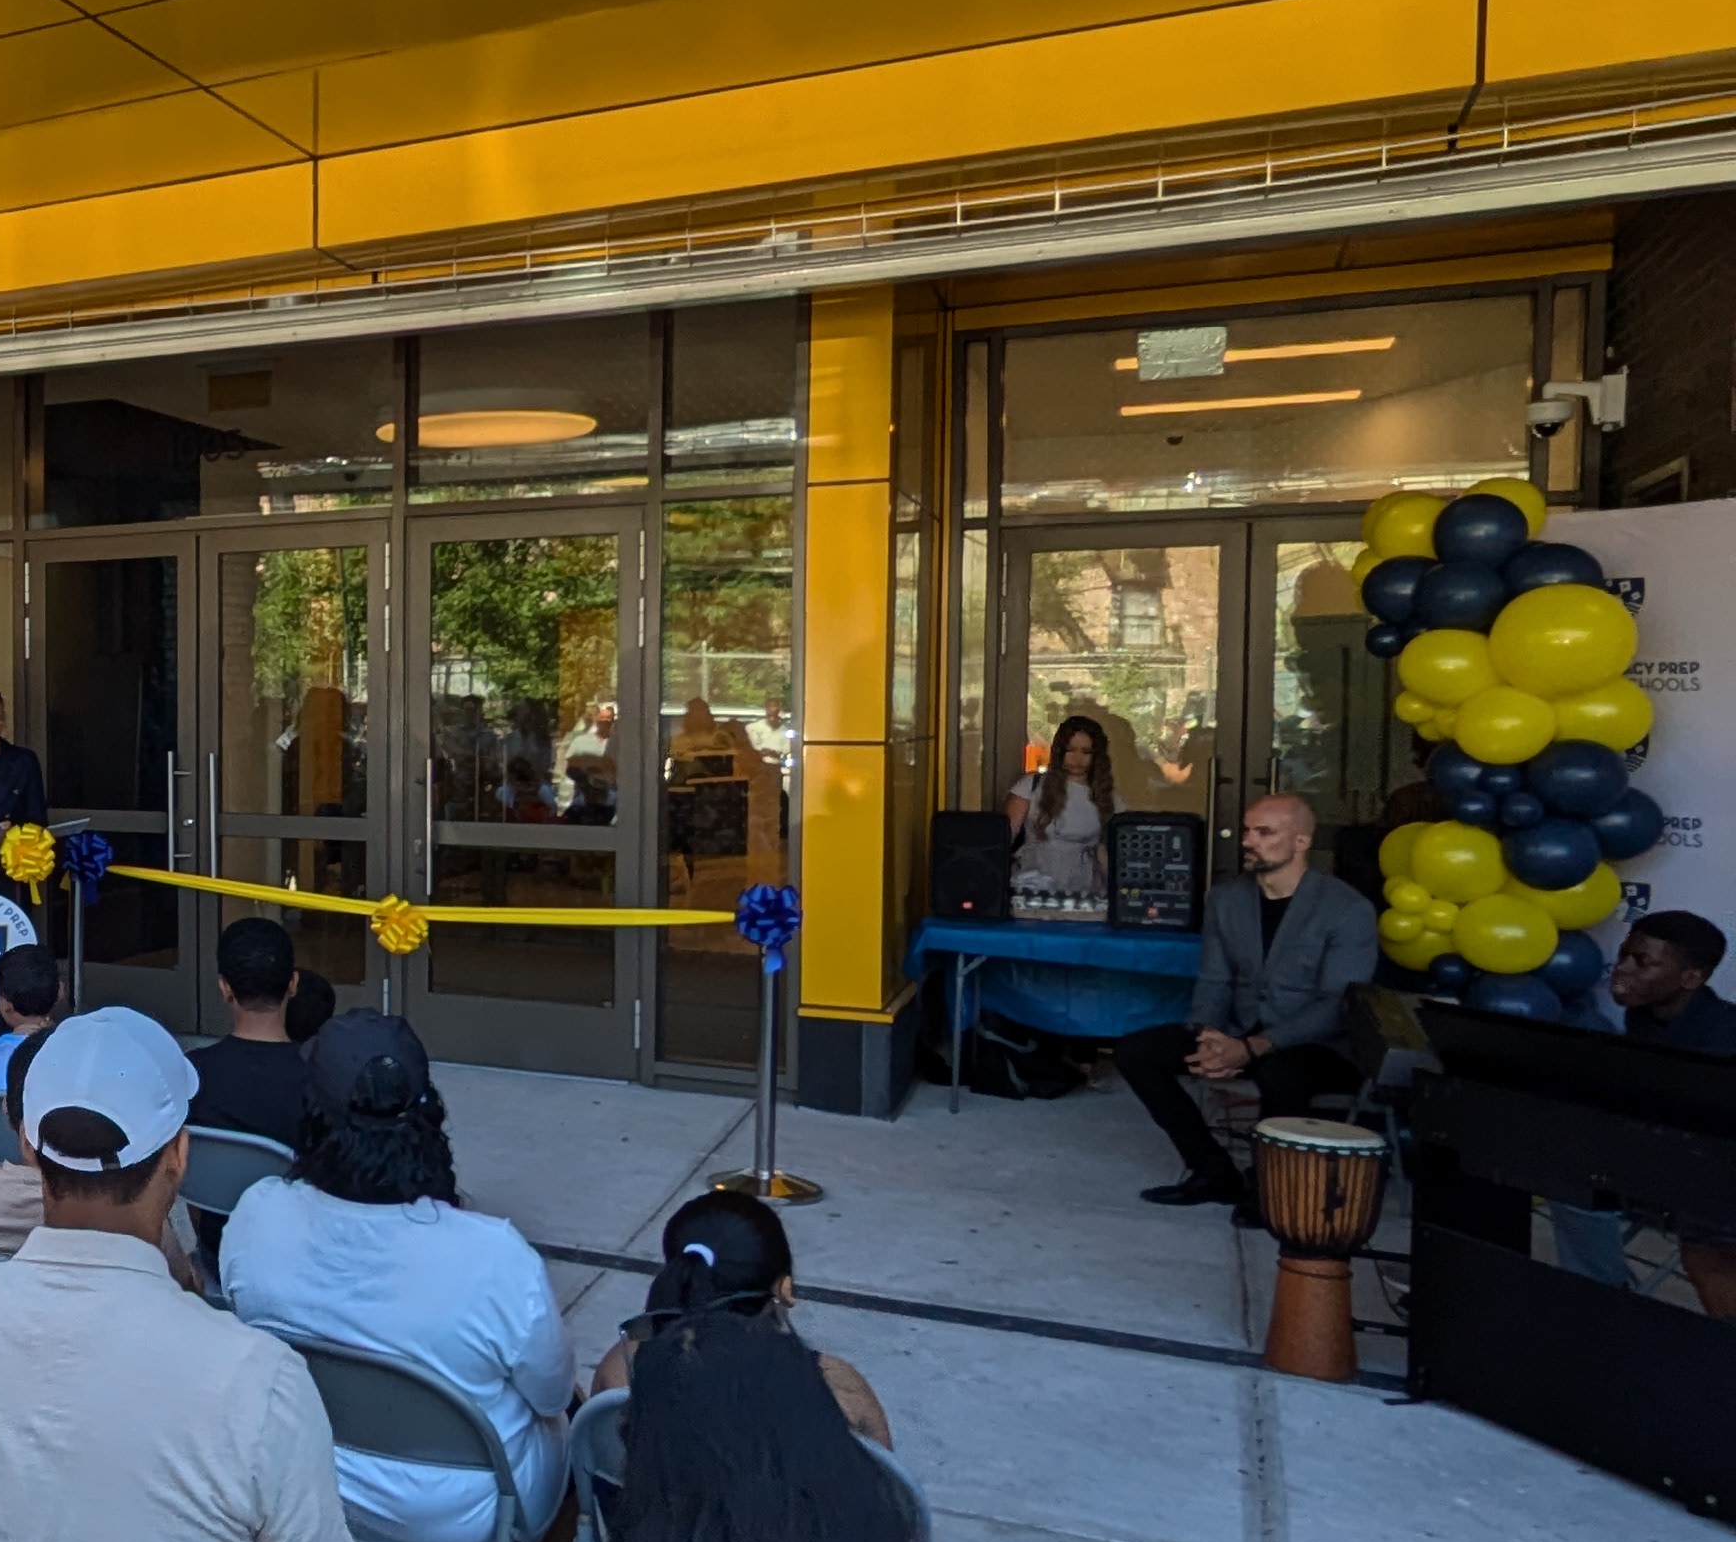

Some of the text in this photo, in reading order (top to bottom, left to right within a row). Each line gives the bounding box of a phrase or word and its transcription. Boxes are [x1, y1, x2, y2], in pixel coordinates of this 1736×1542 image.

[1658, 661, 1700, 675] PREP
[1660, 816, 1702, 831] PREP
[3, 906, 29, 937] PREP
